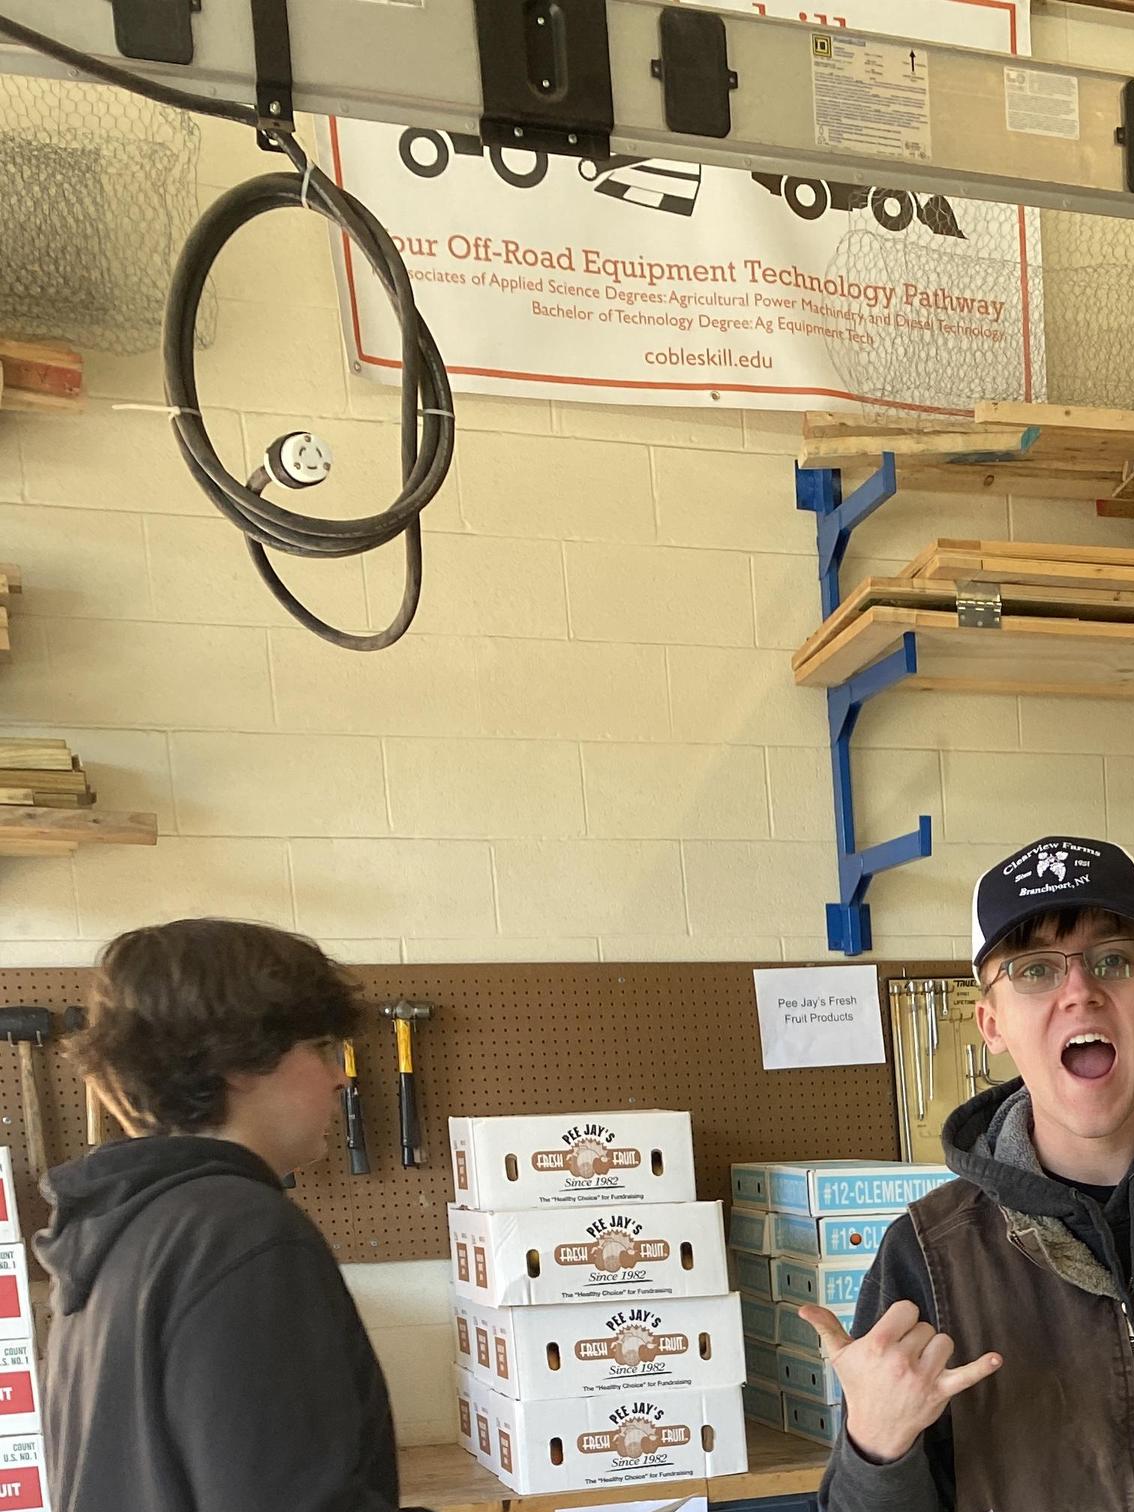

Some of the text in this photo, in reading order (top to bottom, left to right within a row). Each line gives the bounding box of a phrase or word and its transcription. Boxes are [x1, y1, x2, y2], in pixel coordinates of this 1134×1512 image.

[389, 233, 1005, 322] our Off-Road Equipment Technology Pathway
[408, 267, 466, 285] sociates
[471, 272, 488, 286] of
[489, 272, 543, 293] Applied
[547, 279, 600, 299] Science
[605, 285, 667, 307] Degrees:
[669, 290, 750, 309] Agricultural
[754, 293, 797, 309] Power
[801, 298, 864, 323] Machinery
[868, 312, 891, 326] and
[895, 314, 934, 331] Diesel
[531, 301, 874, 346] Bachelor of Technology Degree: Ag Equipment Tech
[645, 347, 773, 370] cobleskill.edu
[1003, 842, 1101, 875] Clearview Farms
[1019, 874, 1090, 896] Branchport, NY
[778, 996, 857, 1009] Pee Jay's Fresh
[785, 1012, 853, 1024] Fruit Products
[561, 1123, 615, 1145] PEE JAY'S
[536, 1153, 564, 1168] FRESH
[612, 1150, 637, 1165] FRUIT
[565, 1176, 619, 1188] Since 1982
[823, 1177, 951, 1206] #12-CLEMENTIN
[586, 1215, 643, 1238] PEE JAY'S
[559, 1245, 588, 1262] FRESH
[640, 1243, 665, 1258] FRUIT
[588, 1270, 646, 1282] Since 1982
[606, 1309, 661, 1332] PEE JAY'S
[4, 1347, 27, 1356] COUNT
[580, 1341, 608, 1357] FRESH
[658, 1337, 684, 1352] FRUIT
[609, 1363, 666, 1375] Since 1982
[609, 1402, 664, 1425] PEE JAY'S
[582, 1434, 610, 1450] FRESH
[661, 1429, 686, 1444] FRUIT
[13, 1442, 35, 1452] COUNT
[611, 1455, 667, 1467] Since 1982
